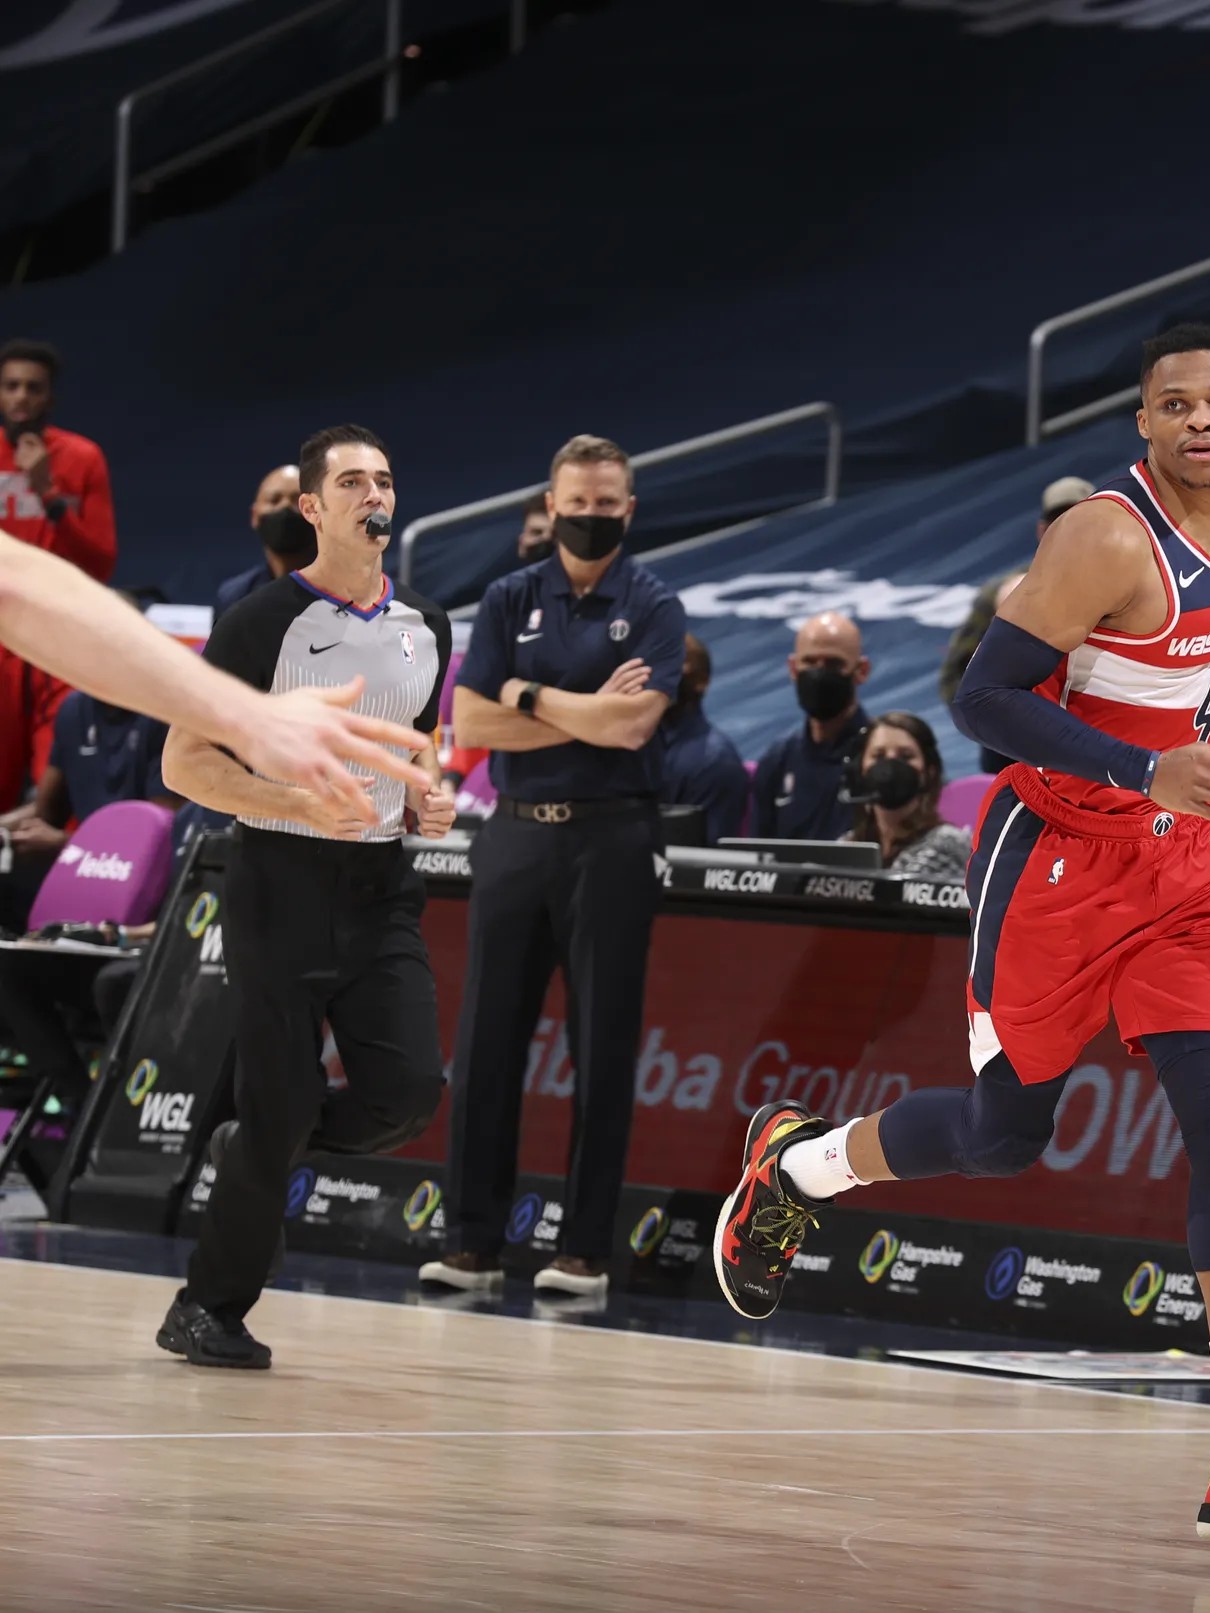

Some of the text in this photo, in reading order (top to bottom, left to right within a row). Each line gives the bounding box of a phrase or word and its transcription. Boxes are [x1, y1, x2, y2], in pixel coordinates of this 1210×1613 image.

[412, 851, 472, 875] #ASKWG
[704, 868, 777, 893] WGL.COM
[804, 876, 875, 901] #ASKWGL
[139, 1092, 195, 1132] WGL
[897, 1241, 963, 1268] Hampshire
[891, 1261, 918, 1283] Gas
[1024, 1256, 1101, 1285] Washington
[1017, 1276, 1044, 1297] Gas
[1164, 1273, 1196, 1295] WGL
[1155, 1294, 1206, 1321] Energy
